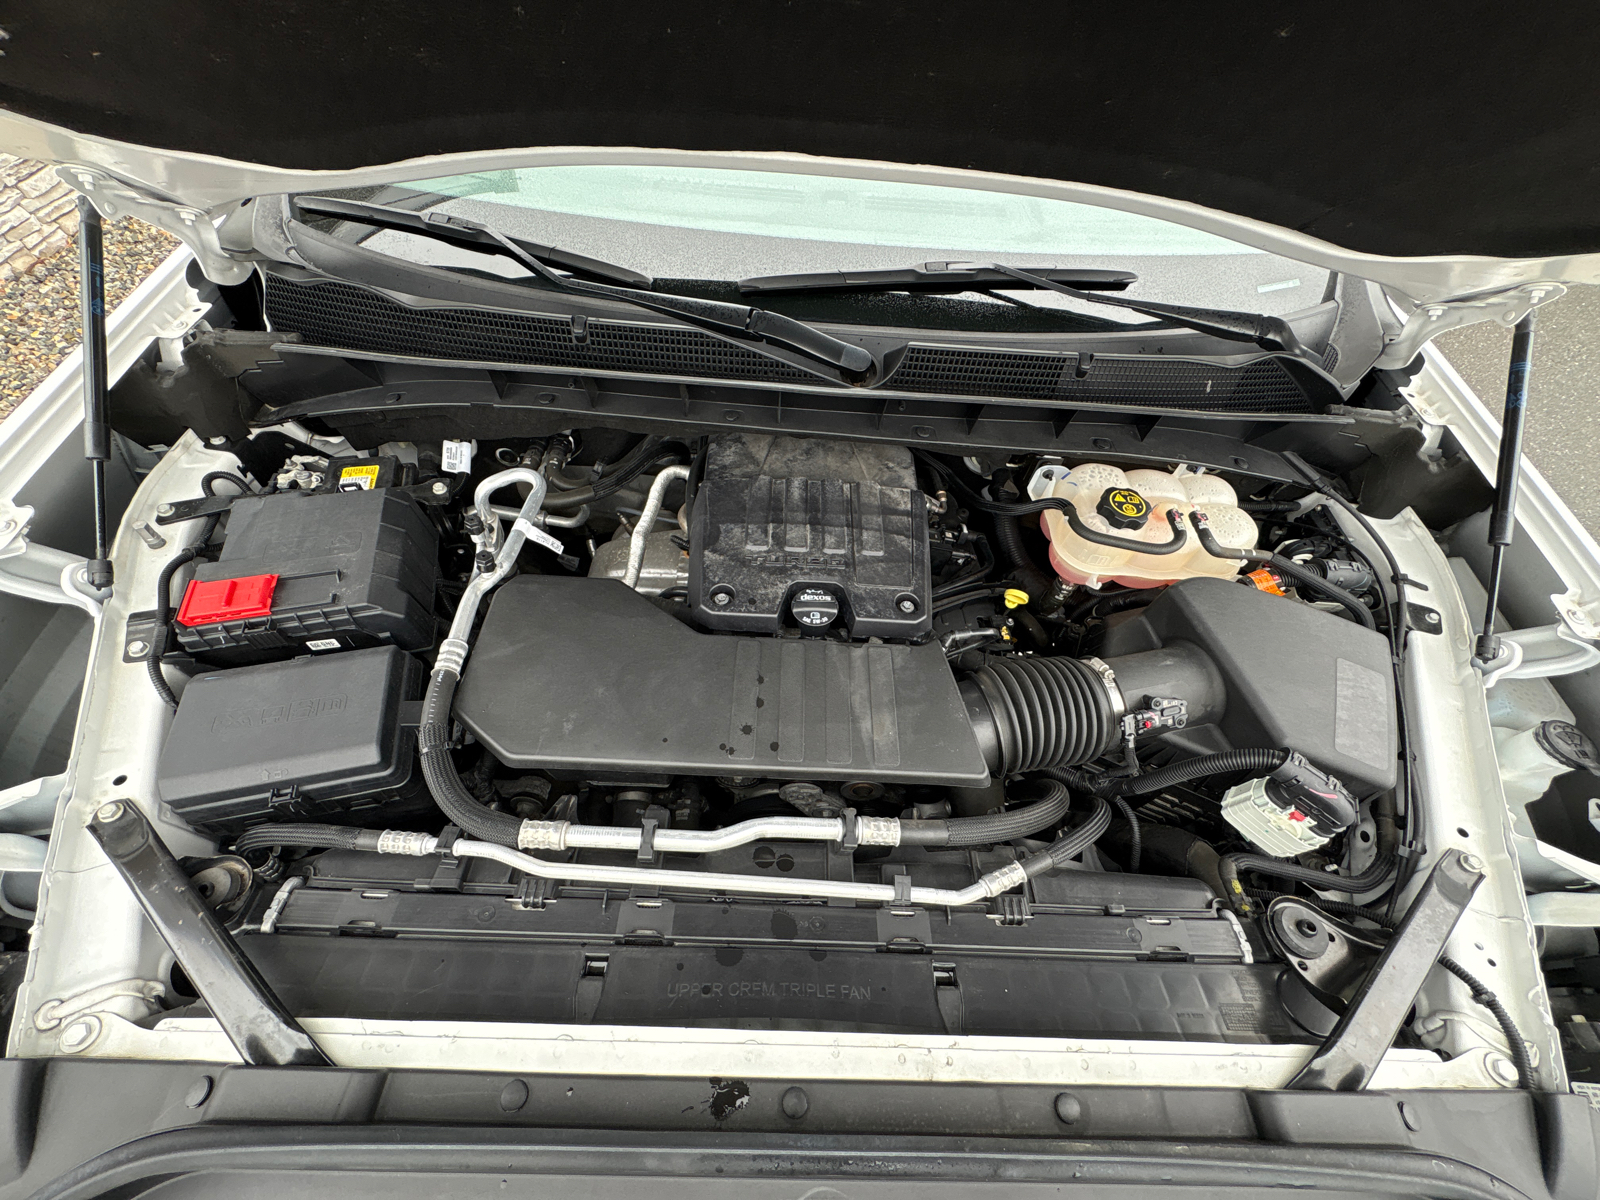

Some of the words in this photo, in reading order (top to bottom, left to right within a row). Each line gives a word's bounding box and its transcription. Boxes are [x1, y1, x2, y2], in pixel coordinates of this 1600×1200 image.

[800, 593, 832, 601] dexos
[779, 982, 836, 998] TRIPLE
[840, 985, 871, 1000] FAN
